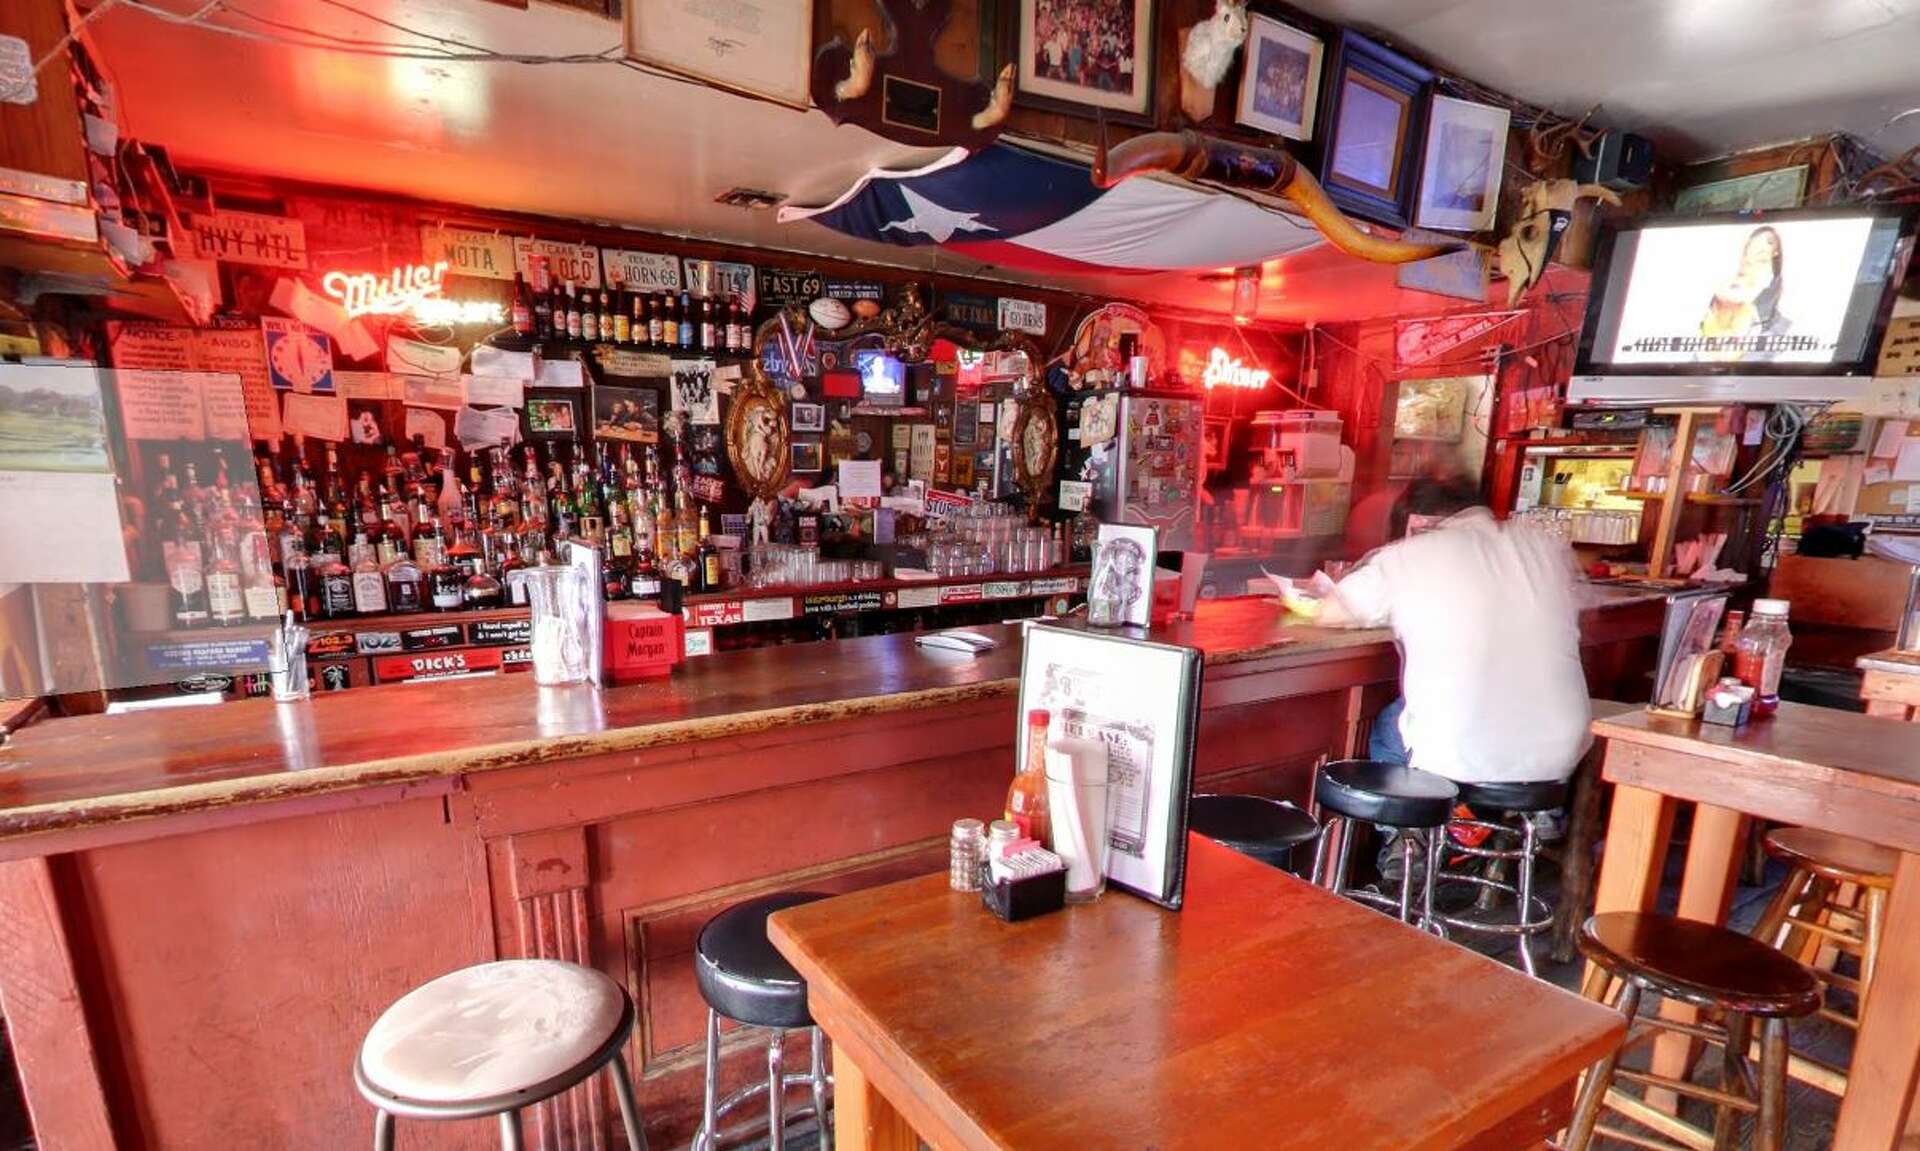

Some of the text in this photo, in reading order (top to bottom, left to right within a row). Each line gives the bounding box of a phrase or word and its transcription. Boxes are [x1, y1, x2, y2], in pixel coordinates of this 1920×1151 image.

[322, 260, 448, 320] Miller
[761, 274, 798, 293] FAST
[802, 278, 820, 295] 69
[211, 337, 251, 350] AVISO
[699, 614, 741, 626] TEXAS
[627, 624, 663, 639] Captain
[626, 642, 665, 657] Morgan
[412, 654, 466, 671] DICK'S
